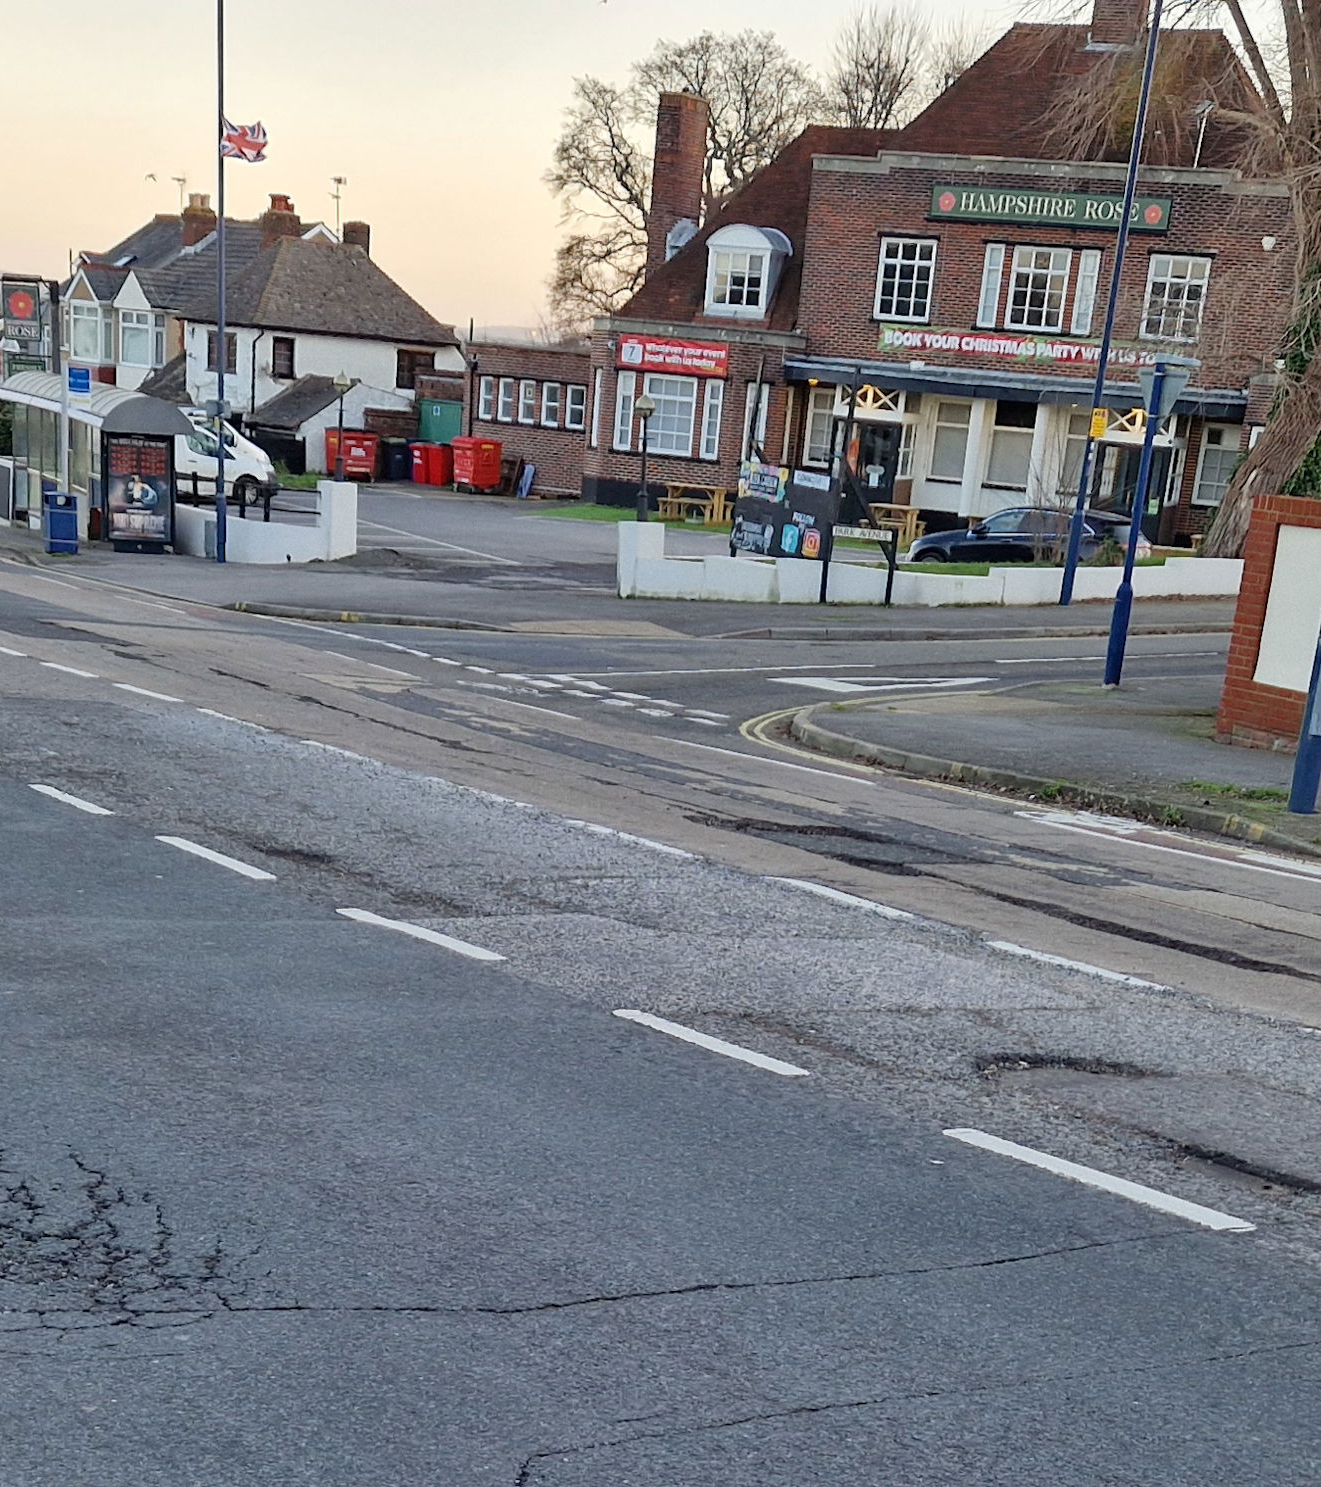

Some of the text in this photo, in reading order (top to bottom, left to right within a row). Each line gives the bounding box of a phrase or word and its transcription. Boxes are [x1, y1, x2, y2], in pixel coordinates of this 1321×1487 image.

[960, 191, 1140, 222] HAMPSHIRE ROSE
[7, 324, 39, 337] ROSE
[884, 328, 923, 346] BOOK
[924, 333, 960, 349] YOUR
[961, 337, 1035, 356] CHRISTMAS
[1036, 343, 1080, 359] PARTY
[629, 346, 636, 357] 7
[834, 527, 888, 540] PARK AVENUE
